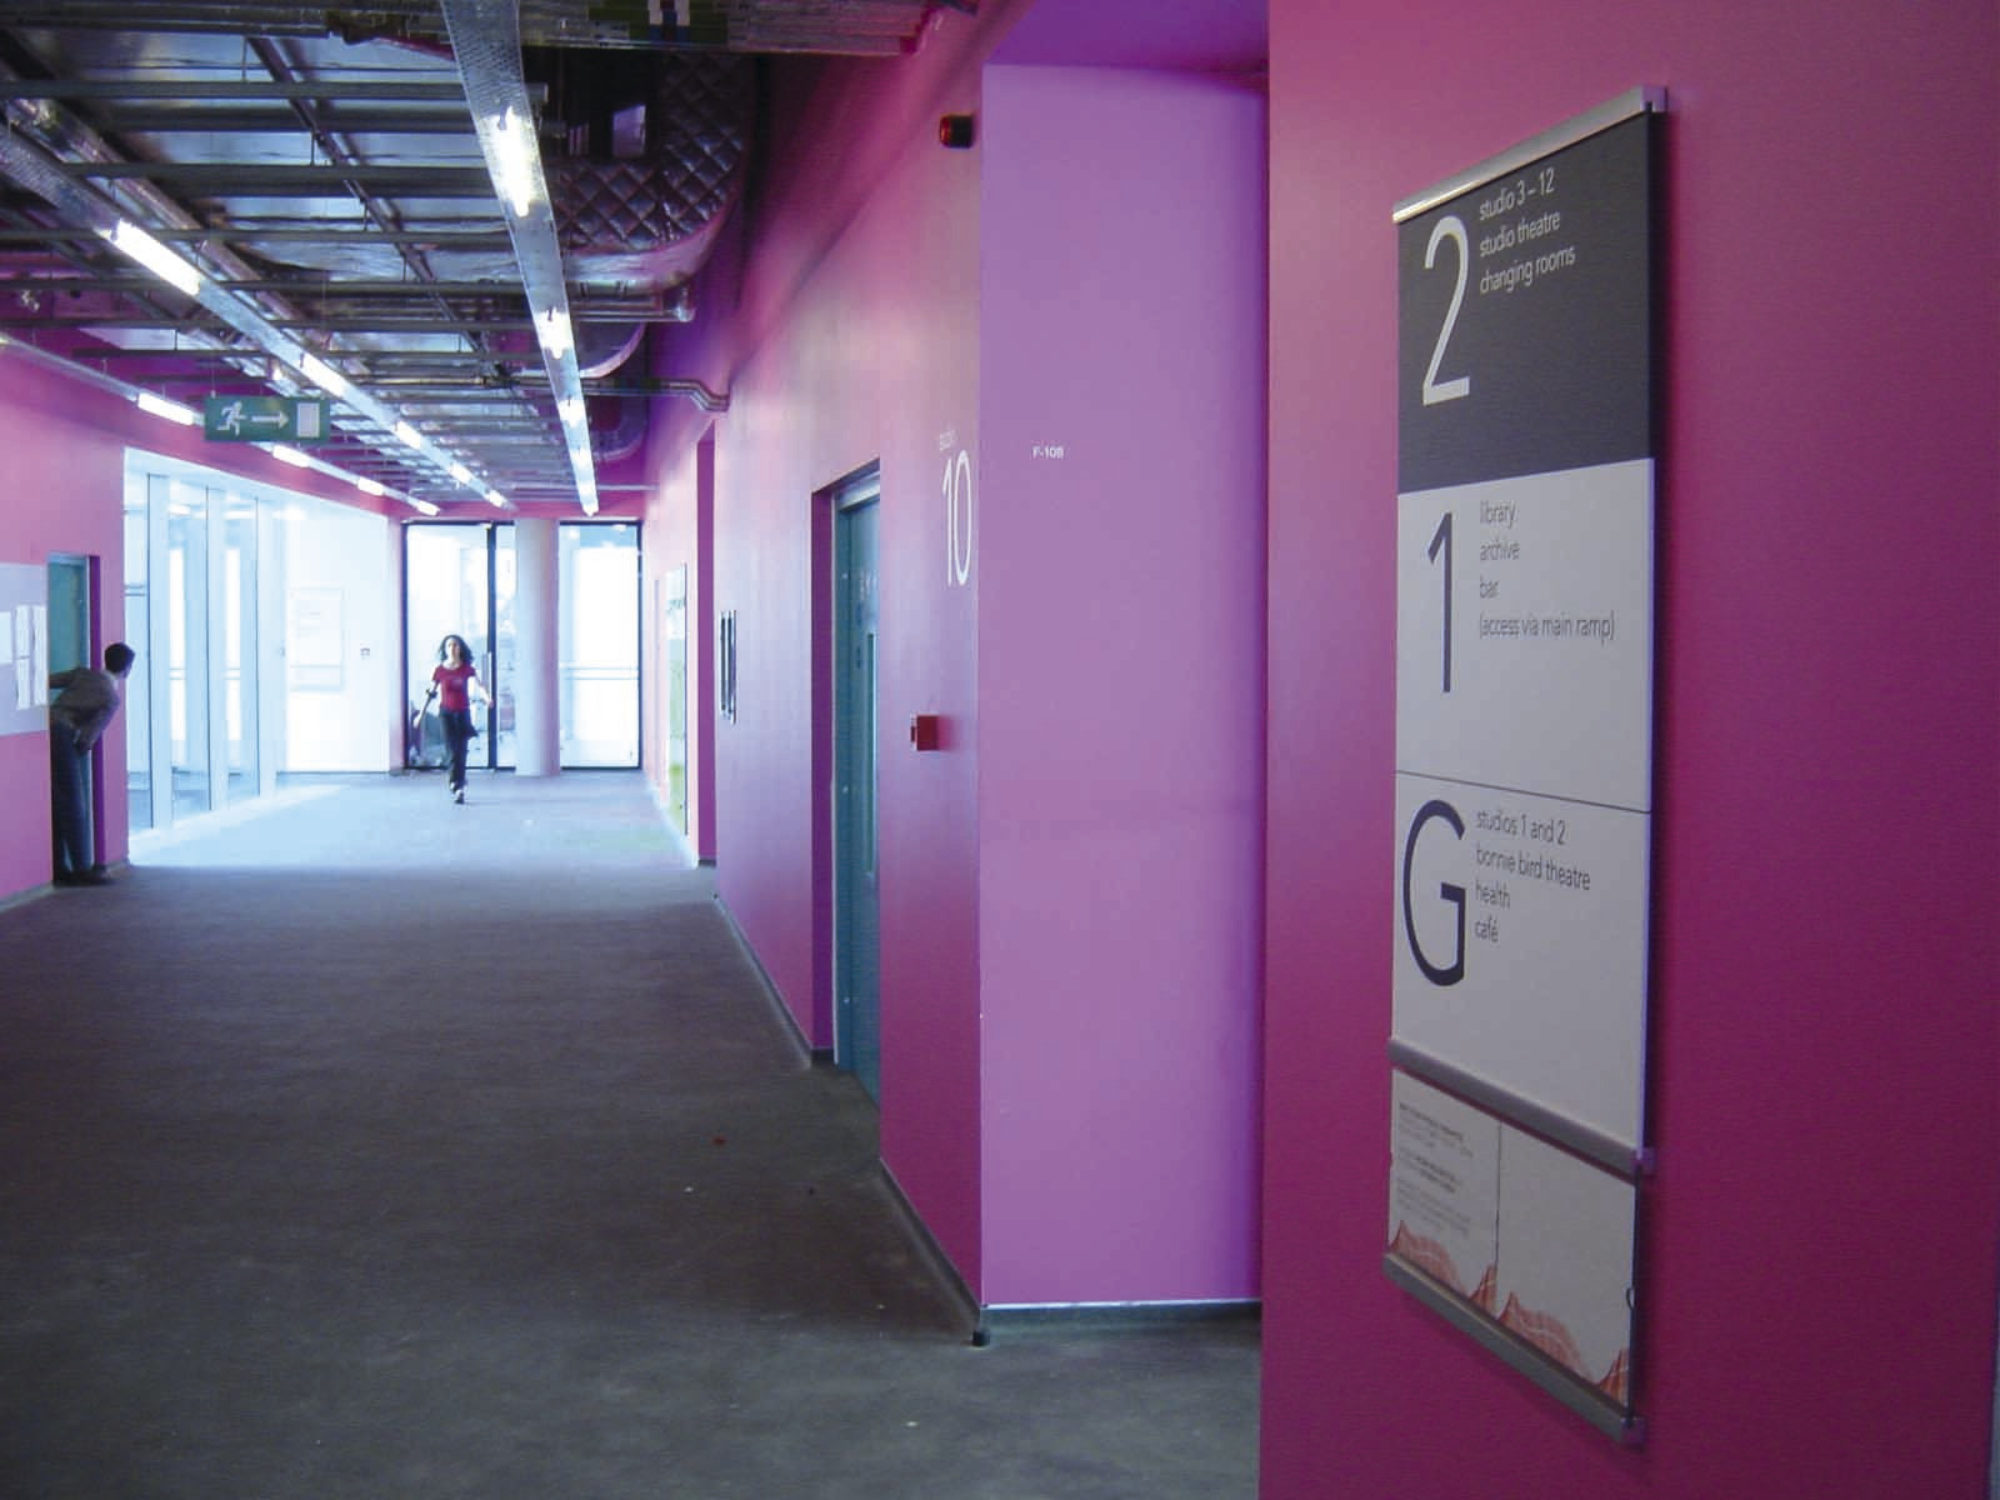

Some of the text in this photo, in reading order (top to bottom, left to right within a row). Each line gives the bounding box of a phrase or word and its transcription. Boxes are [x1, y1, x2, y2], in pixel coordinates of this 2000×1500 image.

[1479, 187, 1515, 221] studio
[1517, 180, 1526, 205] 3
[1540, 167, 1555, 195] 12
[1479, 211, 1561, 257] studio theatre
[1479, 246, 1576, 294] changing rooms
[1422, 215, 1470, 406] 2
[942, 449, 972, 587] 10
[1479, 500, 1517, 529] library
[1479, 538, 1520, 561] archive
[1427, 511, 1453, 693] 1
[1479, 575, 1500, 599] bar
[1479, 610, 1615, 648] (access via main ramp)
[1476, 809, 1567, 846] studios 1 and 2
[1476, 844, 1592, 891] bonnie bird theatre
[1403, 799, 1466, 987] G
[1475, 879, 1511, 910] health
